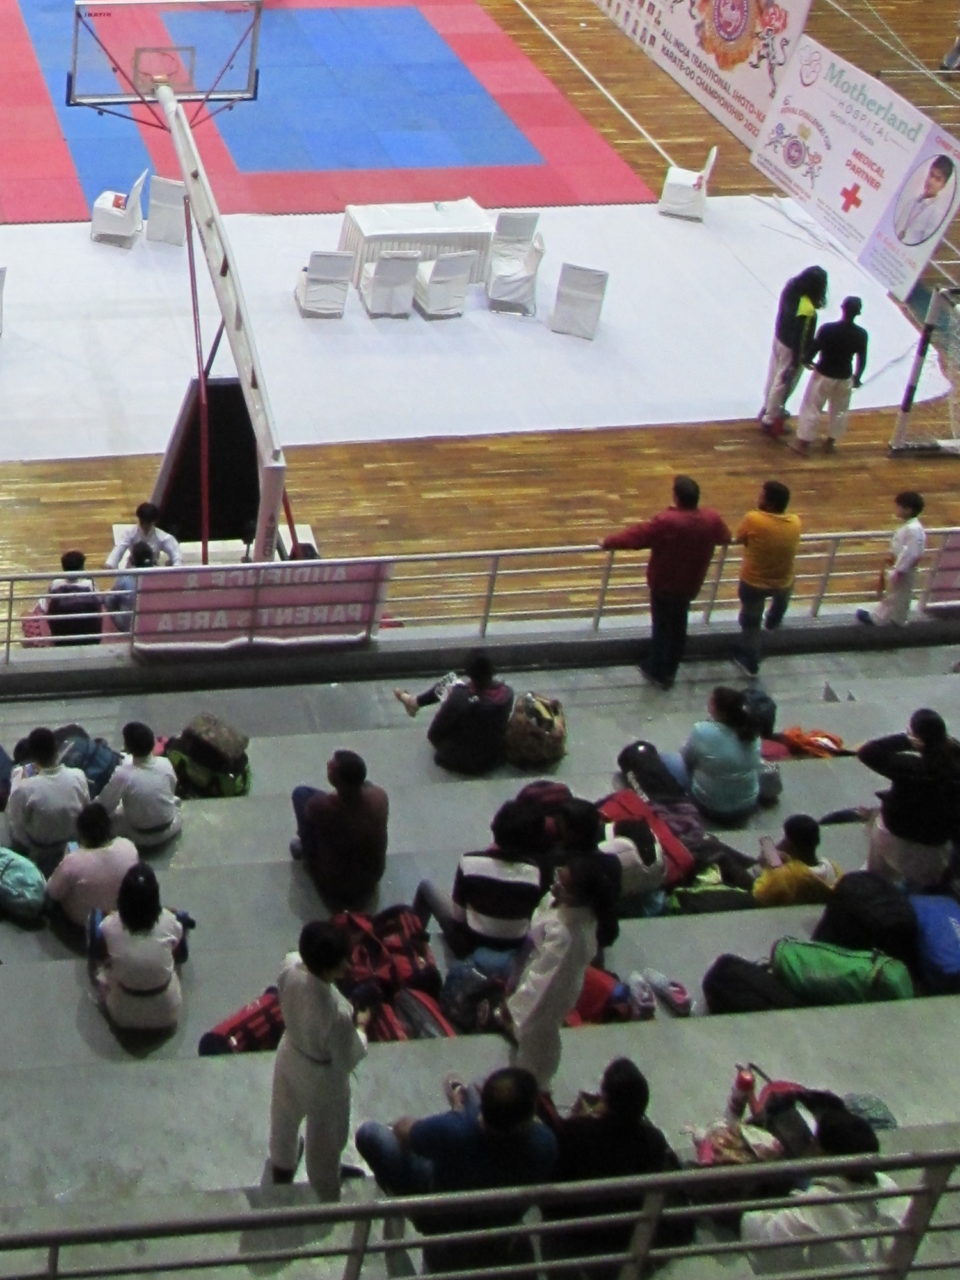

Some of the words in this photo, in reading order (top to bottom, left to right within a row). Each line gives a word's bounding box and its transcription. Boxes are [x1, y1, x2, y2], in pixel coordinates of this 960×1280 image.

[661, 28, 673, 45] ALL
[673, 38, 690, 59] INDIA
[690, 53, 732, 96] TRADITIONAL
[695, 76, 744, 122] CHAMPIONSHIP
[824, 62, 924, 143] Motherland
[838, 100, 890, 142] HOSPITAL
[844, 159, 882, 192] PARTNER
[851, 148, 885, 179] MEDICAL
